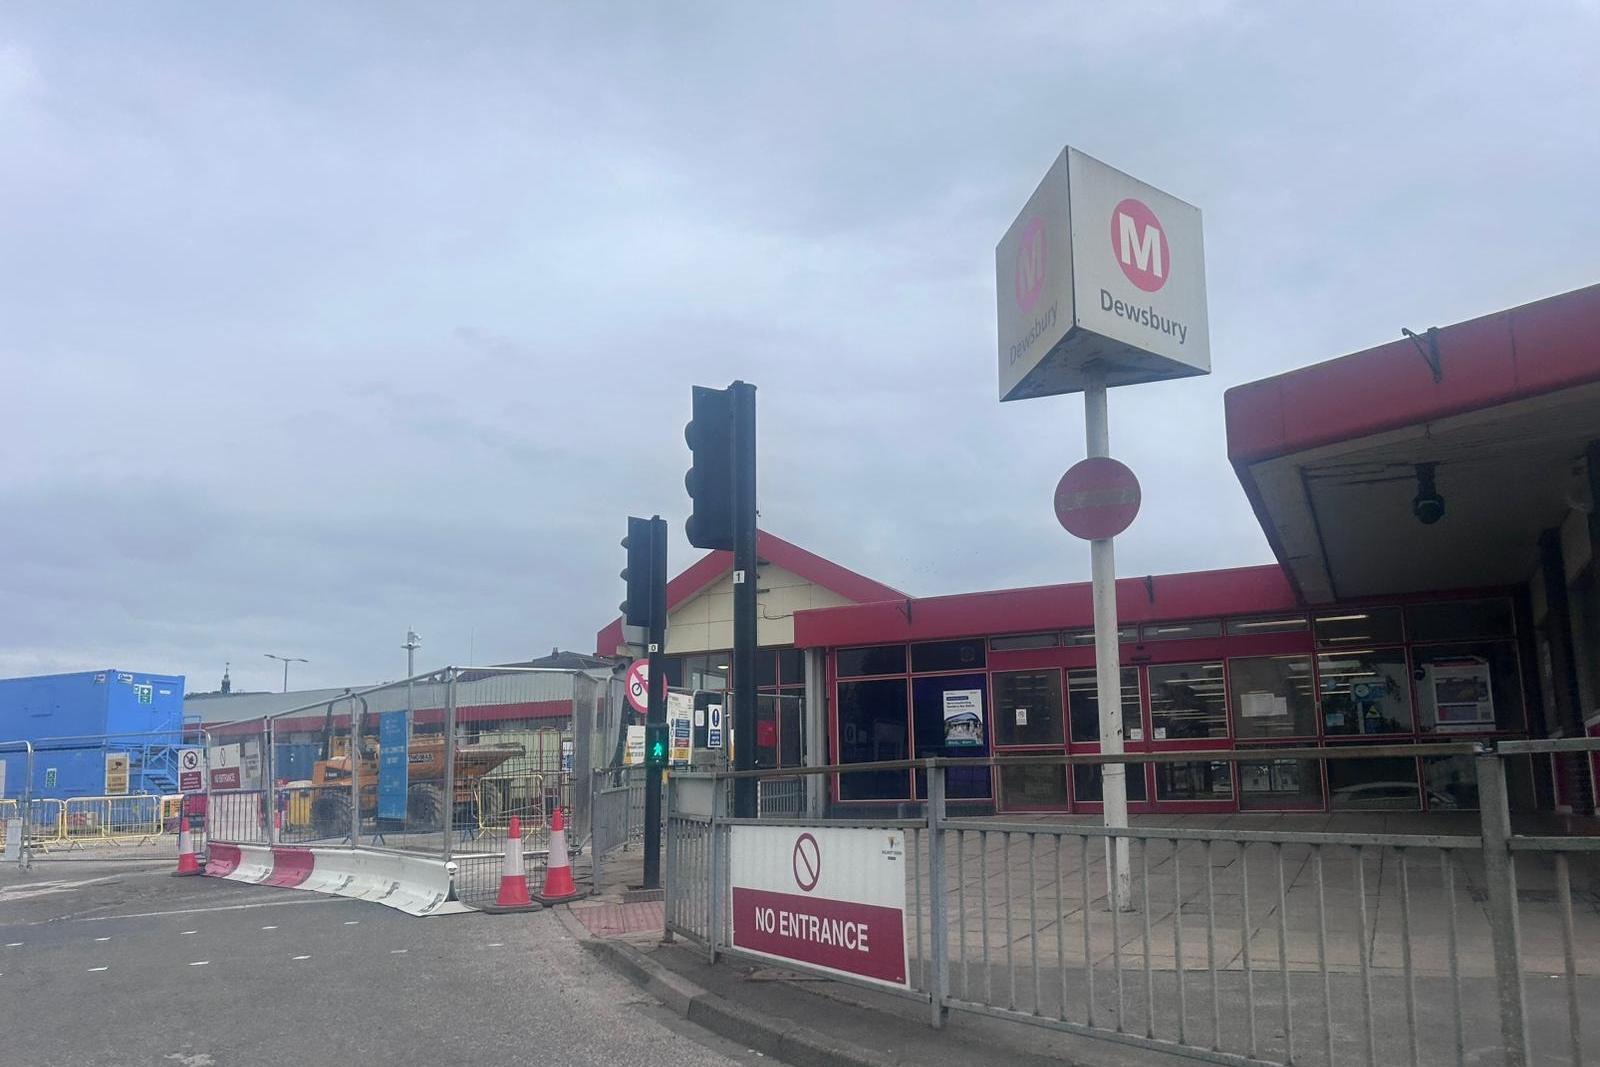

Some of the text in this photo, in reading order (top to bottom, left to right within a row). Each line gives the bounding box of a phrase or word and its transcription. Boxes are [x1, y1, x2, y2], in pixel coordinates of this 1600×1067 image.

[1119, 212, 1162, 279] M
[1010, 300, 1058, 365] Dewsbury
[1100, 288, 1187, 345] Dewsbury
[755, 906, 869, 952] NO ENTRANCE
